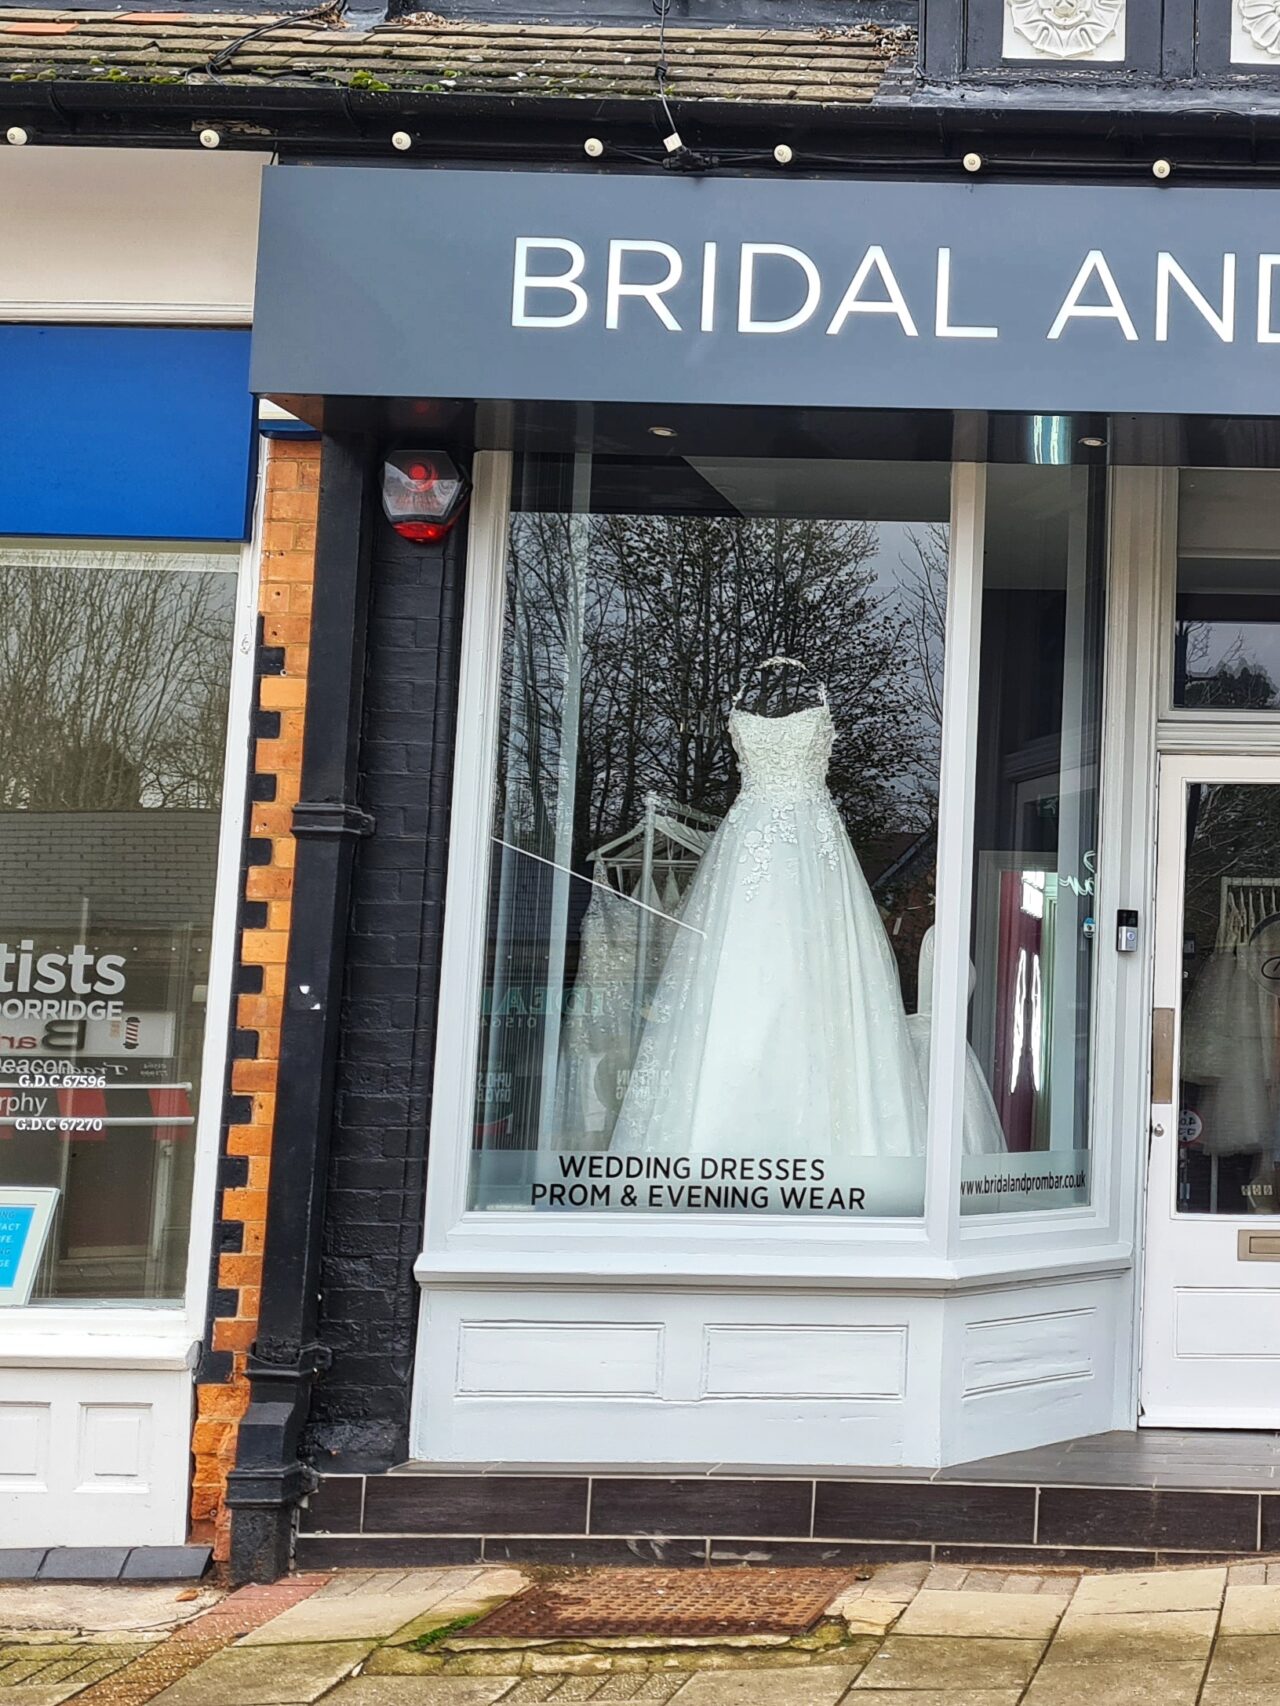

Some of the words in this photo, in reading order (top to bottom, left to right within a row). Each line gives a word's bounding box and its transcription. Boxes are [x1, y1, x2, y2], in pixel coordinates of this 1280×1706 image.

[511, 236, 999, 339] BRIDAL
[0, 998, 124, 1020] ORRIDGE
[0, 1056, 74, 1075] eacon
[18, 1075, 60, 1088] G.D.C
[62, 1075, 106, 1088] 67596
[15, 1117, 56, 1131] G.D.C
[59, 1117, 103, 1131] 67270
[558, 1155, 690, 1180] WEDDING
[701, 1157, 825, 1182] DRESSES
[531, 1183, 611, 1208] PROM
[620, 1184, 639, 1208] &
[648, 1185, 769, 1210] EVENING
[780, 1187, 866, 1211] WEAR
